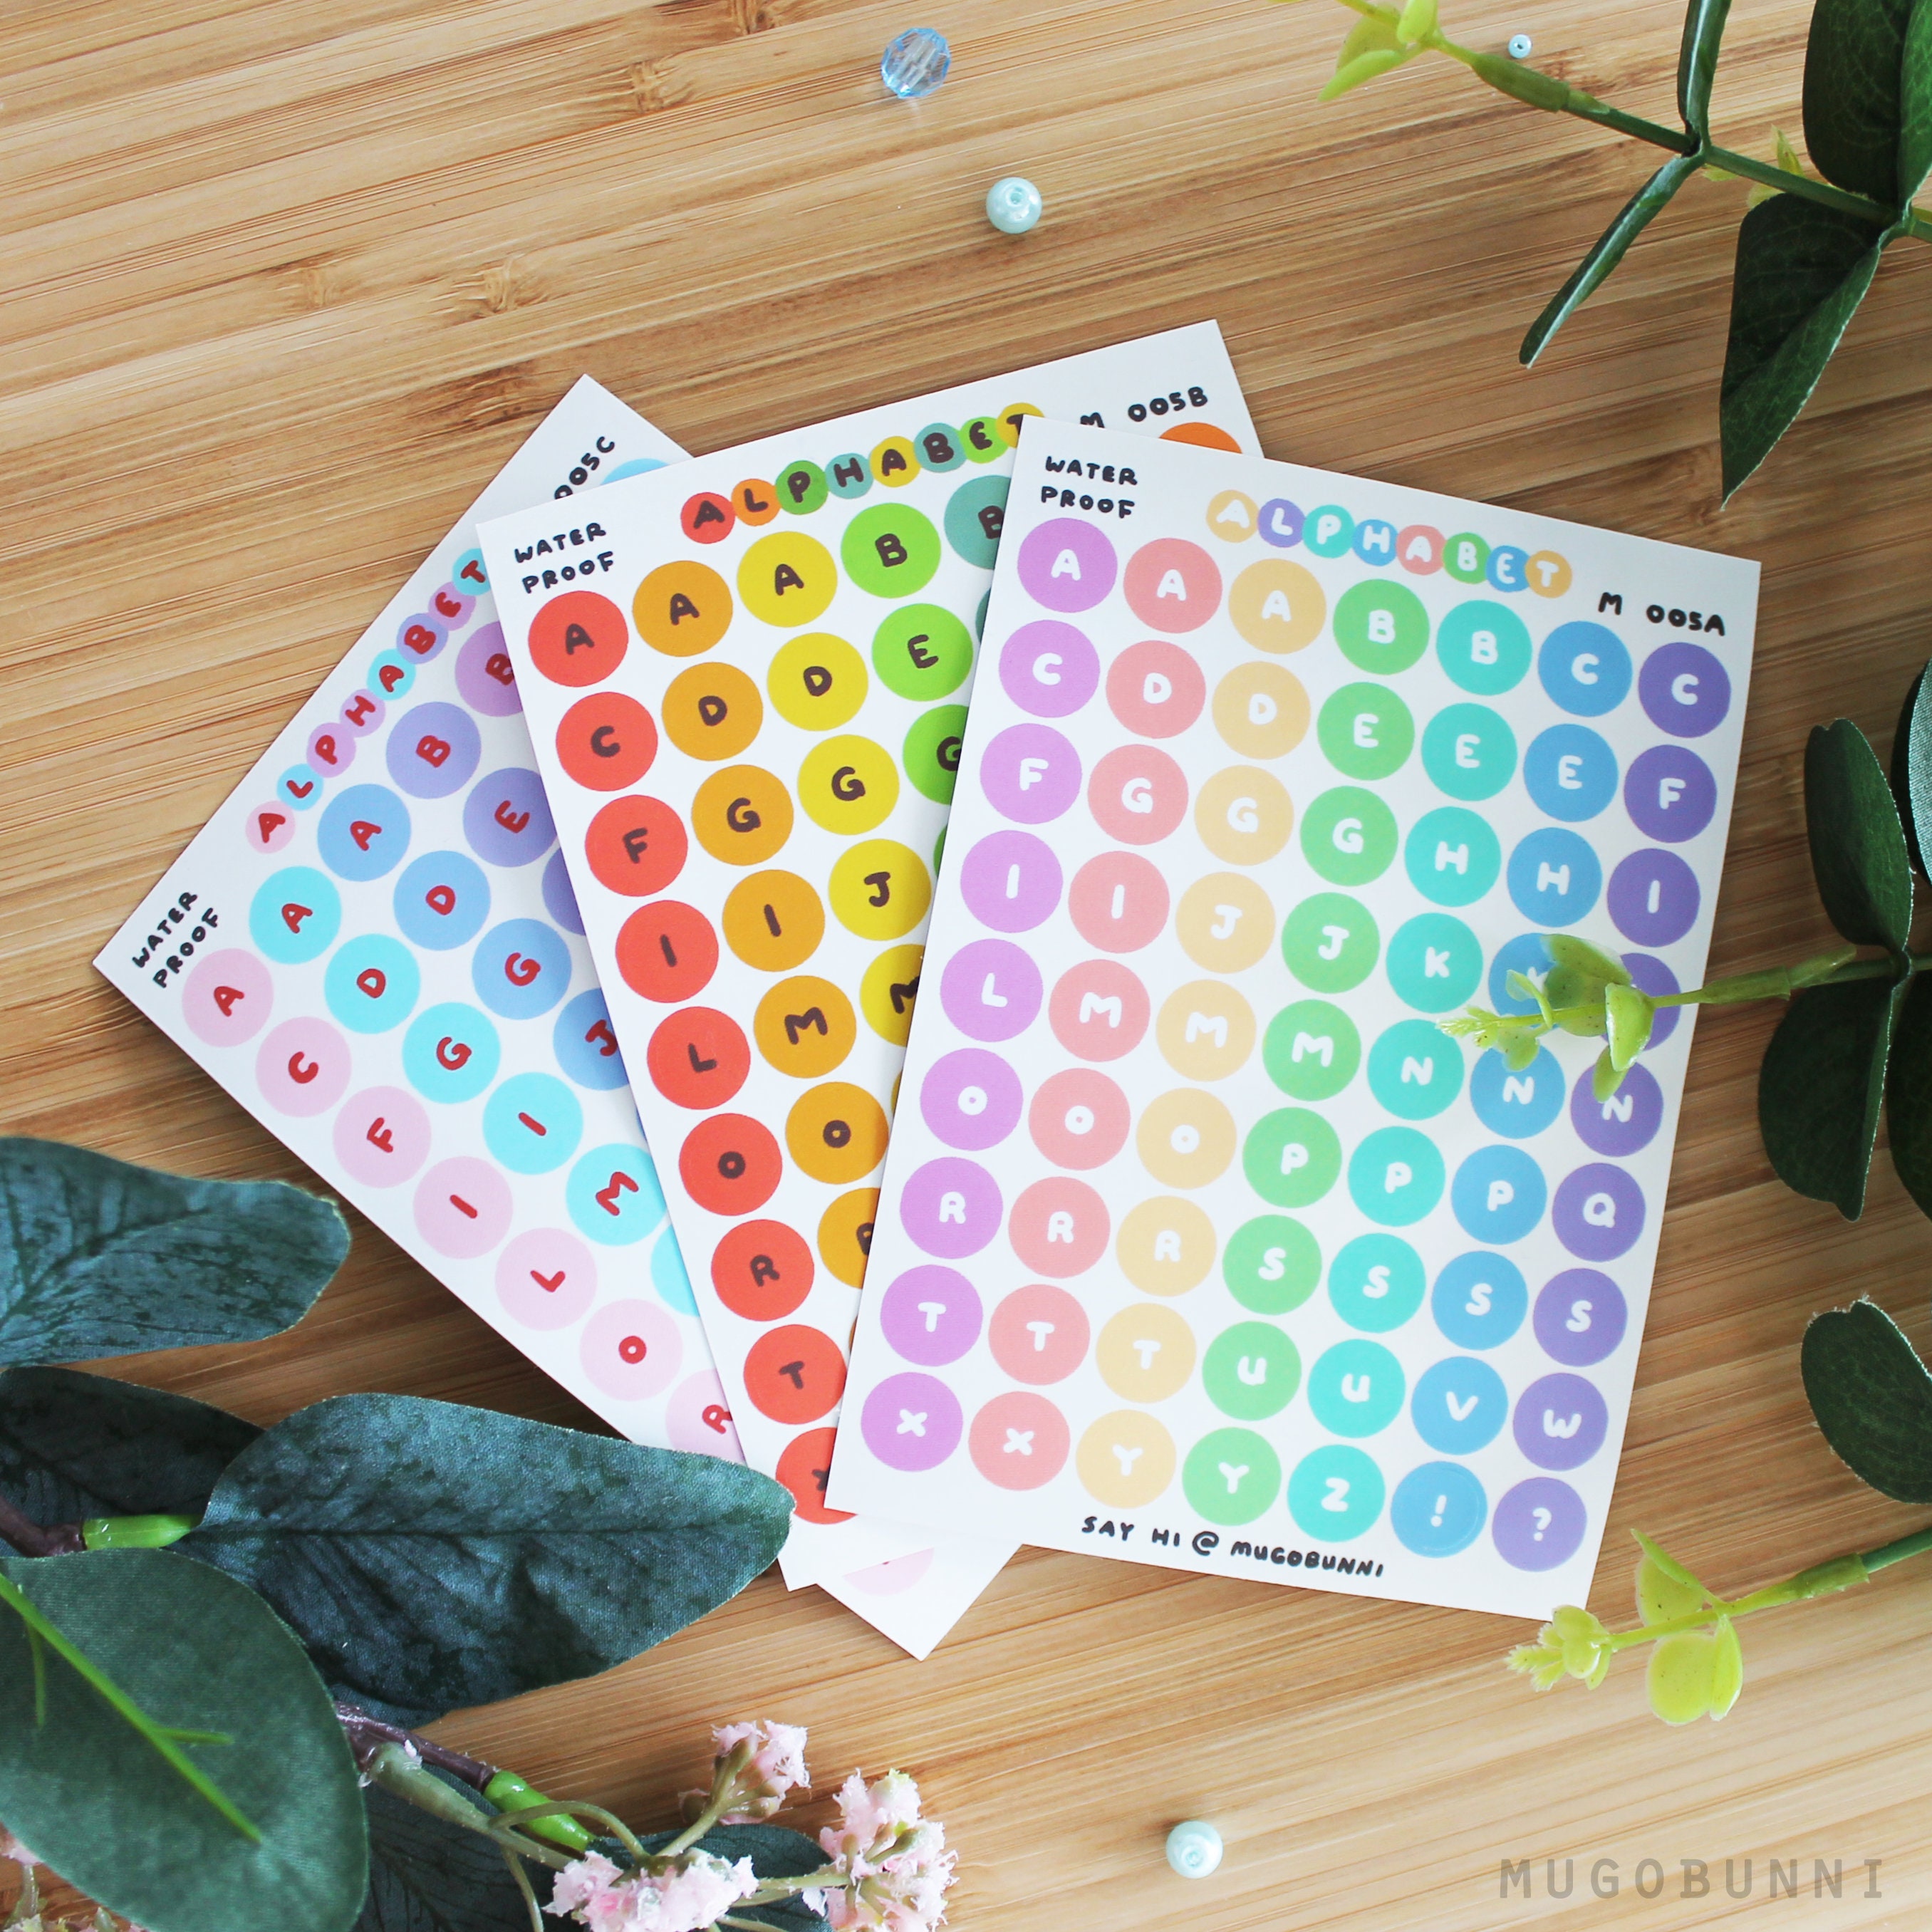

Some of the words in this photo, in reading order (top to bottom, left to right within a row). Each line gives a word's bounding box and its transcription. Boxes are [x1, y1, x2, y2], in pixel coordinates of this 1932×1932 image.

[1127, 386, 1208, 422] 005B
[1041, 486, 1135, 519] PROOF
[1045, 455, 1138, 486] WATER
[514, 522, 606, 564] WATER
[521, 551, 613, 594] PROOF
[1215, 499, 1559, 587] ALPHABET
[565, 623, 594, 655] A
[669, 593, 700, 626] A
[774, 563, 805, 596] A
[874, 533, 908, 568] B
[1051, 549, 1082, 581] A
[1156, 568, 1188, 602] A
[1260, 589, 1292, 623] A
[1368, 608, 1396, 644] B
[1471, 630, 1498, 665] B
[1572, 653, 1599, 684] C
[1672, 673, 1699, 705] C
[1598, 591, 1623, 616] M
[1646, 604, 1725, 637] 005A
[259, 560, 486, 843] ALPHABET
[591, 725, 620, 758] C
[697, 695, 728, 727] D
[802, 665, 833, 697] D
[907, 634, 940, 669] E
[1032, 653, 1064, 685] C
[1143, 672, 1173, 704] D
[1247, 692, 1279, 727] D
[1353, 712, 1379, 749] E
[1456, 734, 1480, 768] E
[1559, 755, 1582, 789] E
[1659, 777, 1686, 809] F
[623, 828, 648, 864] F
[726, 797, 762, 833] G
[831, 766, 866, 802] G
[1019, 757, 1049, 791] F
[1121, 777, 1154, 814] G
[1226, 796, 1260, 834] G
[1331, 817, 1364, 854] G
[1435, 841, 1469, 874] H
[1537, 862, 1570, 895] H
[213, 985, 245, 1017] A
[281, 903, 313, 935] A
[349, 820, 383, 852] A
[415, 734, 451, 768] B
[863, 871, 891, 908] J
[132, 892, 198, 968] WATER
[152, 907, 218, 989] PROOF
[288, 1051, 320, 1084] C
[355, 967, 387, 999] D
[425, 884, 457, 916] D
[494, 800, 530, 833] E
[1210, 903, 1243, 940] J
[1317, 924, 1350, 960] J
[1425, 947, 1450, 977] K
[366, 1116, 394, 1153] F
[435, 1036, 473, 1071] G
[504, 952, 542, 987] G
[586, 1019, 618, 1056] J
[688, 1043, 717, 1073] L
[784, 1007, 829, 1045] M
[981, 972, 1008, 1007] L
[1079, 992, 1123, 1029] M
[1185, 1011, 1229, 1049] M
[1291, 1031, 1334, 1068] M
[1401, 1056, 1434, 1085] N
[1503, 1076, 1535, 1104] N
[1602, 1094, 1633, 1122] N
[717, 1151, 746, 1179] O
[822, 1119, 852, 1149] O
[957, 1085, 988, 1116] O
[1064, 1105, 1095, 1135] O
[1169, 1123, 1200, 1155] O
[1280, 1142, 1309, 1175] P
[1385, 1162, 1413, 1193] P
[1487, 1180, 1515, 1211] P
[1583, 1192, 1616, 1228] Q
[529, 1269, 566, 1293] L
[596, 1172, 638, 1216] M
[750, 1255, 780, 1287] R
[939, 1191, 967, 1224] R
[1046, 1210, 1075, 1244] R
[1153, 1229, 1182, 1263] R
[1257, 1247, 1287, 1281] S
[1363, 1265, 1391, 1299] S
[1465, 1283, 1492, 1316] S
[1566, 1299, 1592, 1332] S
[618, 1335, 648, 1365] O
[779, 1361, 804, 1388] T
[918, 1302, 947, 1332] T
[1026, 1321, 1056, 1352] T
[1132, 1339, 1162, 1371] T
[1237, 1356, 1268, 1386] U
[1341, 1373, 1371, 1403] U
[1446, 1391, 1478, 1421] V
[1542, 1409, 1582, 1439] W
[702, 1404, 734, 1434] R
[896, 1408, 928, 1437] X
[1003, 1428, 1036, 1457] X
[1111, 1443, 1144, 1477] Y
[1218, 1461, 1250, 1494] Y
[1321, 1477, 1350, 1512] Z
[1533, 1507, 1552, 1542] ?
[1081, 1516, 1135, 1541] SAY
[1151, 1528, 1180, 1547] HI
